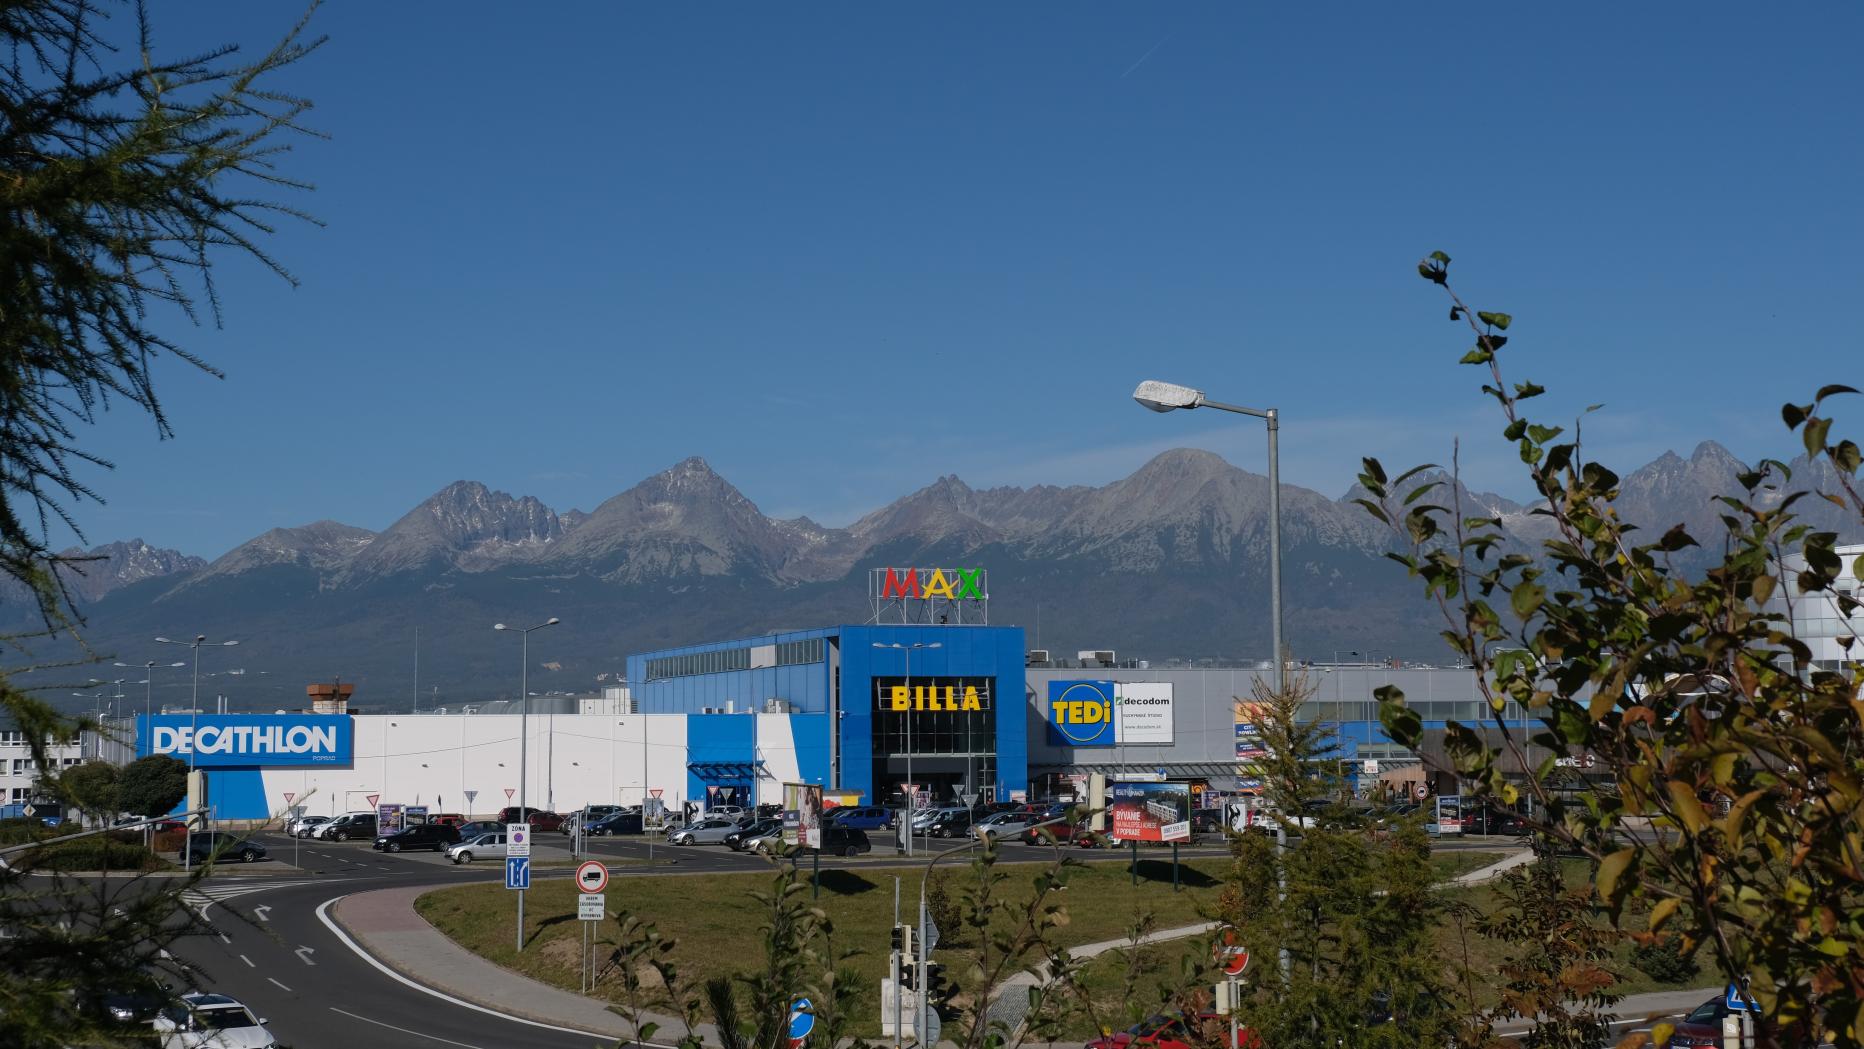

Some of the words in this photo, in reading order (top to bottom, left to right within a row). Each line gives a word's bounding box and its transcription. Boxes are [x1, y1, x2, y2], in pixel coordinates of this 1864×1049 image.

[882, 567, 983, 600] MAX
[891, 685, 981, 711] BILLA
[1124, 697, 1170, 706] decodom
[1052, 700, 1111, 724] TEDi
[153, 725, 337, 755] DECATHLON
